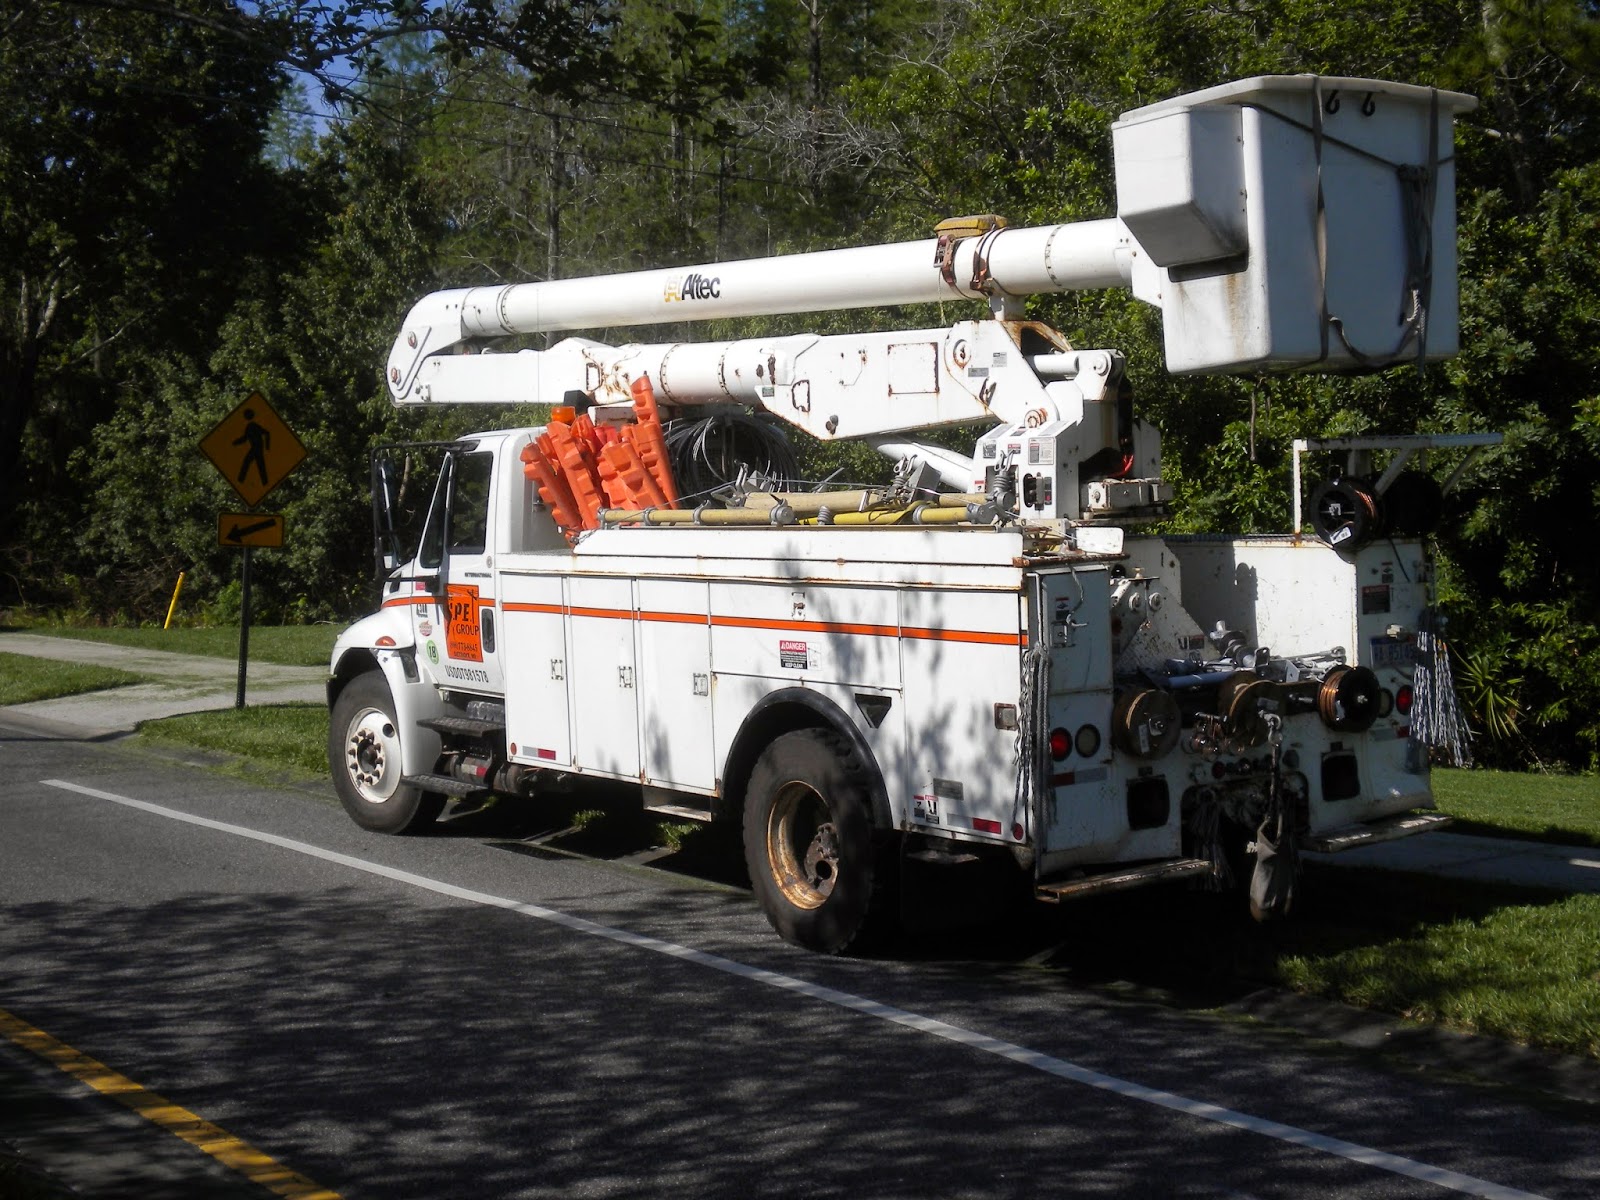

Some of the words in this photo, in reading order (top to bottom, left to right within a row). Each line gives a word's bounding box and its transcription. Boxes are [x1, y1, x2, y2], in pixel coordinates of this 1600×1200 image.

[681, 273, 721, 300] Altec
[455, 623, 480, 636] GROUP
[428, 645, 437, 658] 18
[785, 642, 805, 650] DANGER
[444, 665, 489, 683] USDOT981578
